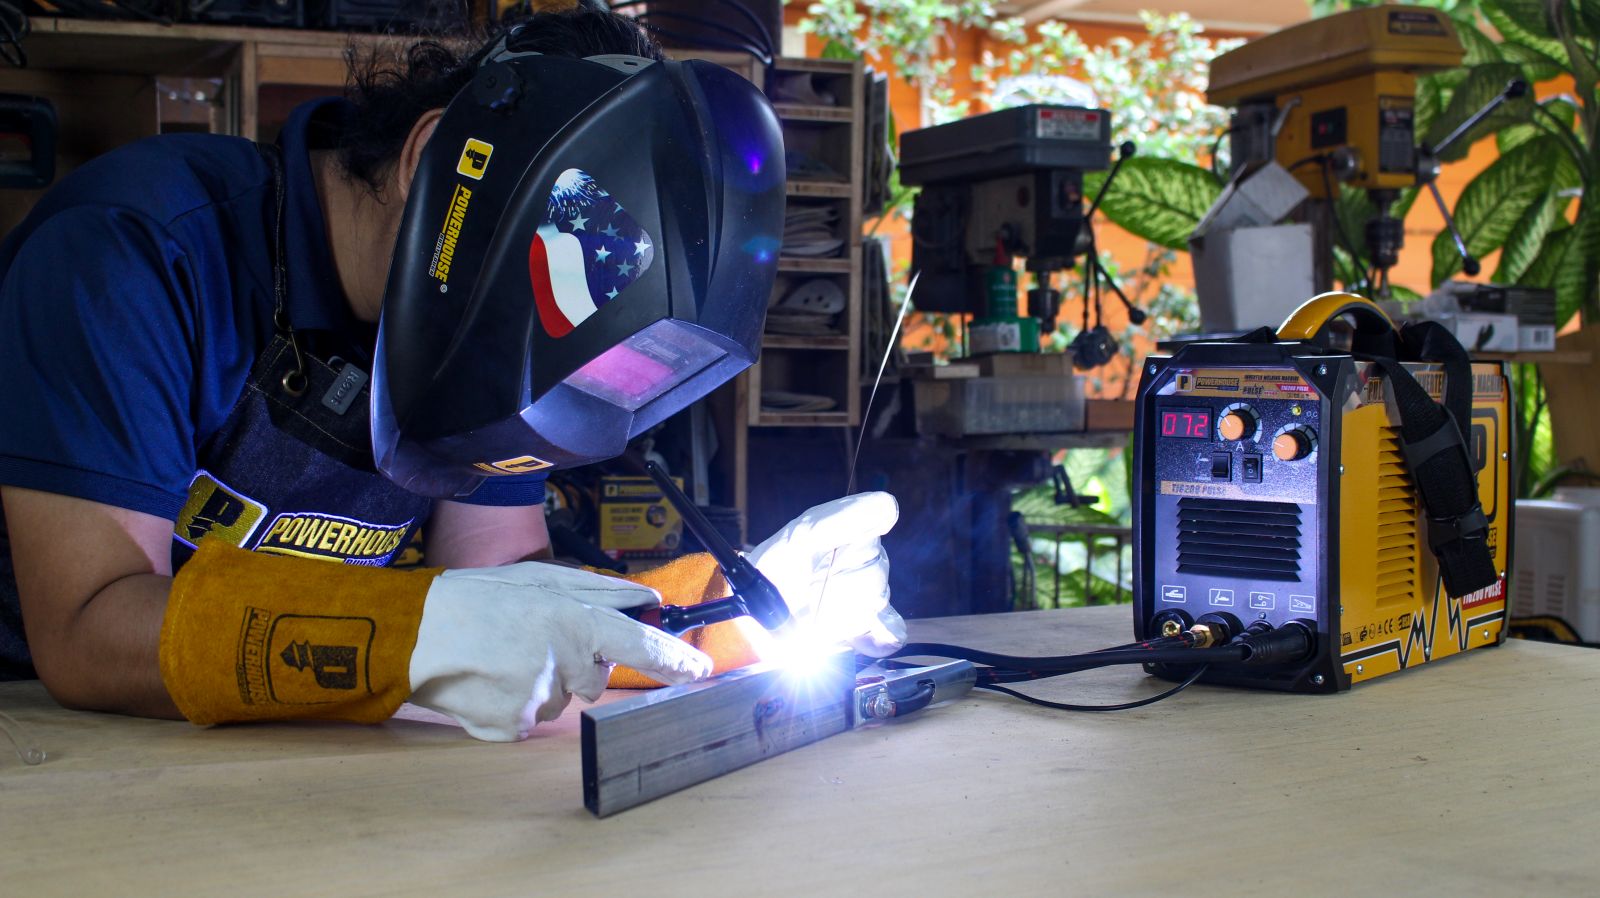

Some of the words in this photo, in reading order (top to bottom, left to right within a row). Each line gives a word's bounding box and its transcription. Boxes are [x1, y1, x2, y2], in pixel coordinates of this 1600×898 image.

[435, 185, 472, 283] POWERHOUSE
[1196, 378, 1239, 387] POWERHOUSE
[1163, 413, 1208, 437] 072
[1235, 442, 1245, 451] A
[263, 516, 408, 556] POWERHOUS
